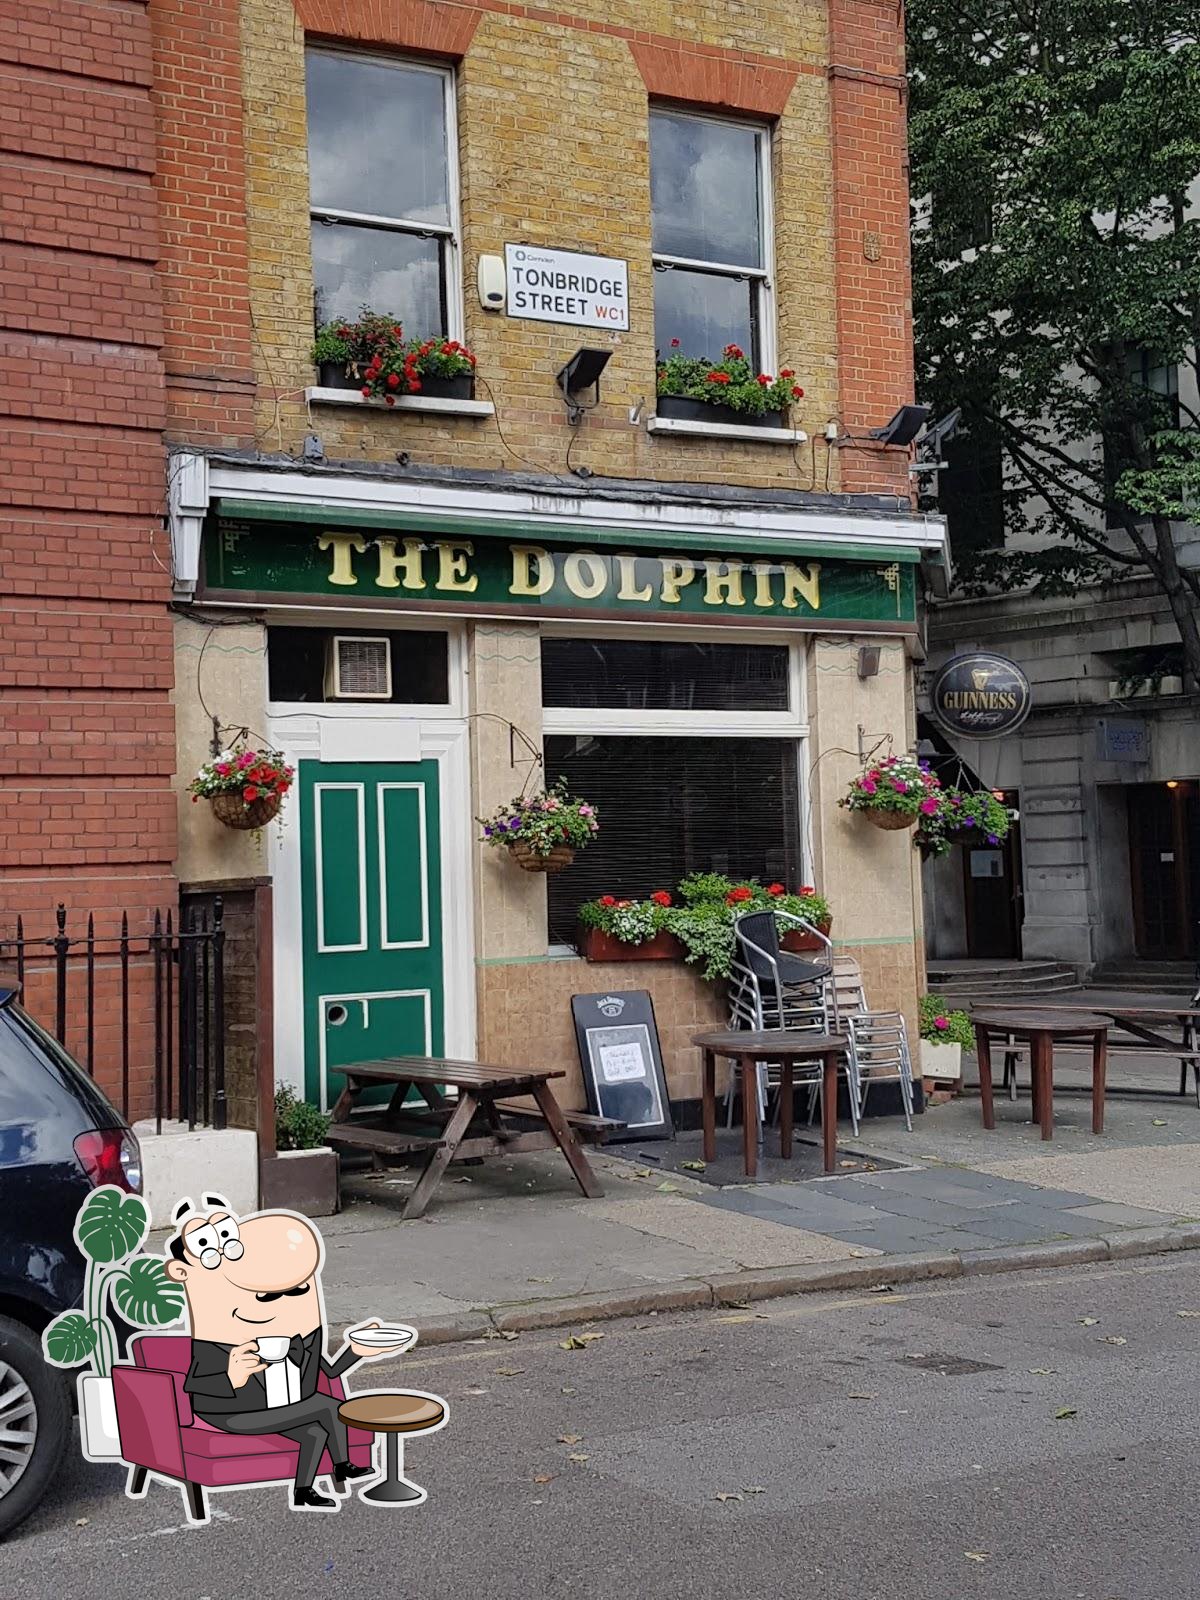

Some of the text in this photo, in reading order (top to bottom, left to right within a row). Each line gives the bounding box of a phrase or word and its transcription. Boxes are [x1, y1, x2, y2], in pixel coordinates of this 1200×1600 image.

[512, 266, 623, 297] TONBRIDGE
[515, 291, 625, 321] STREET WC1
[318, 531, 822, 610] THE DOLPHIN
[943, 691, 1017, 710] GUINNESS
